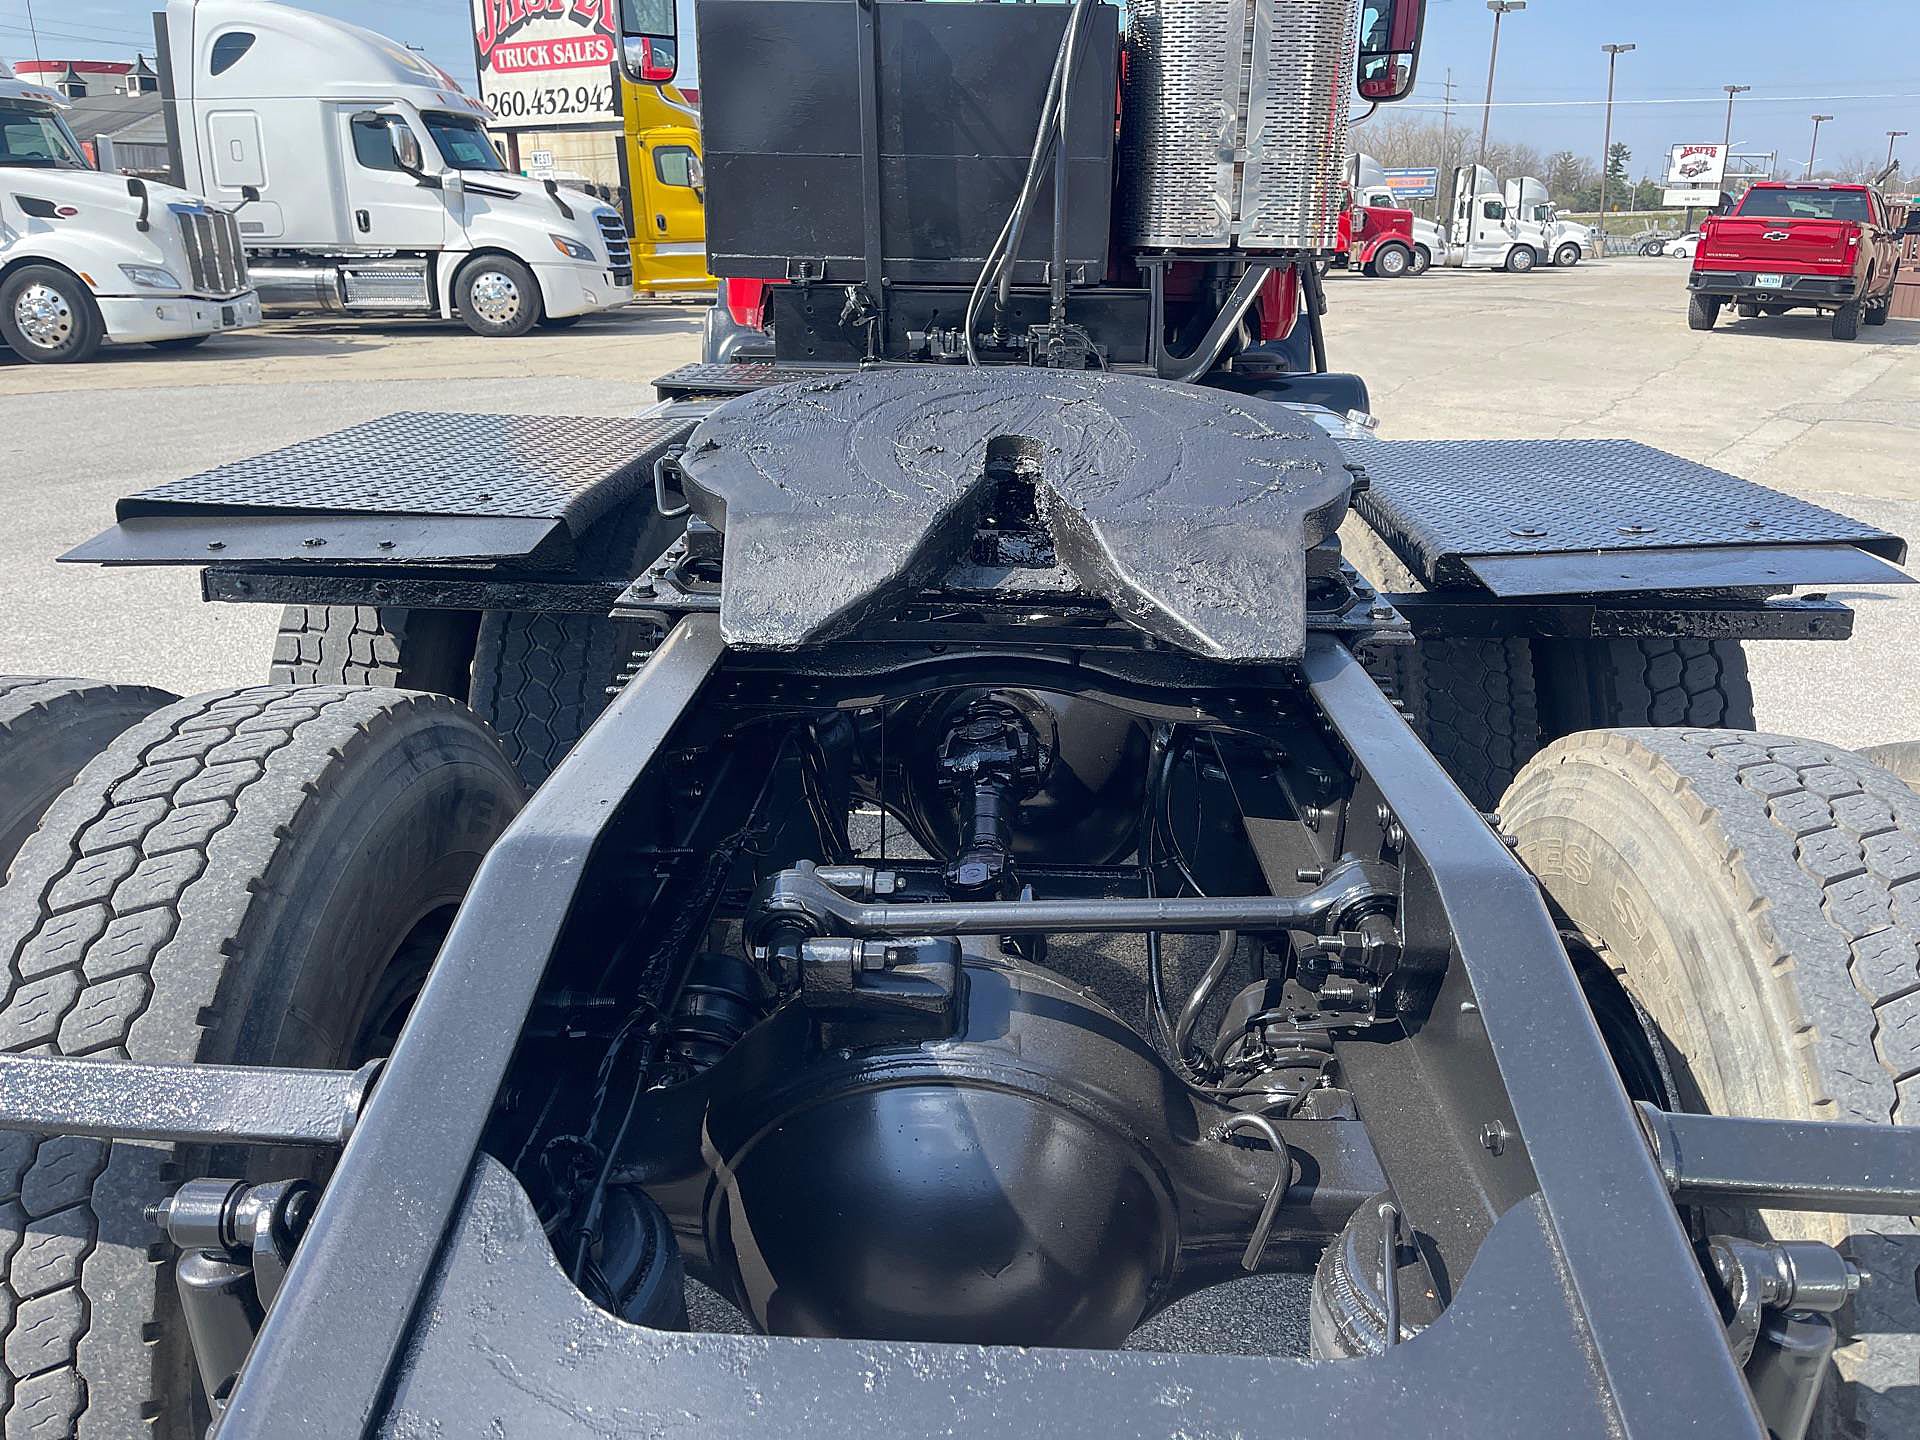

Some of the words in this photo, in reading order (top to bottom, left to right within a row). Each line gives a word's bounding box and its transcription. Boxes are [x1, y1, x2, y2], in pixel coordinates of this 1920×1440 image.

[495, 46, 550, 69] TRUCK
[552, 39, 609, 64] SALES
[533, 153, 550, 164] WEST
